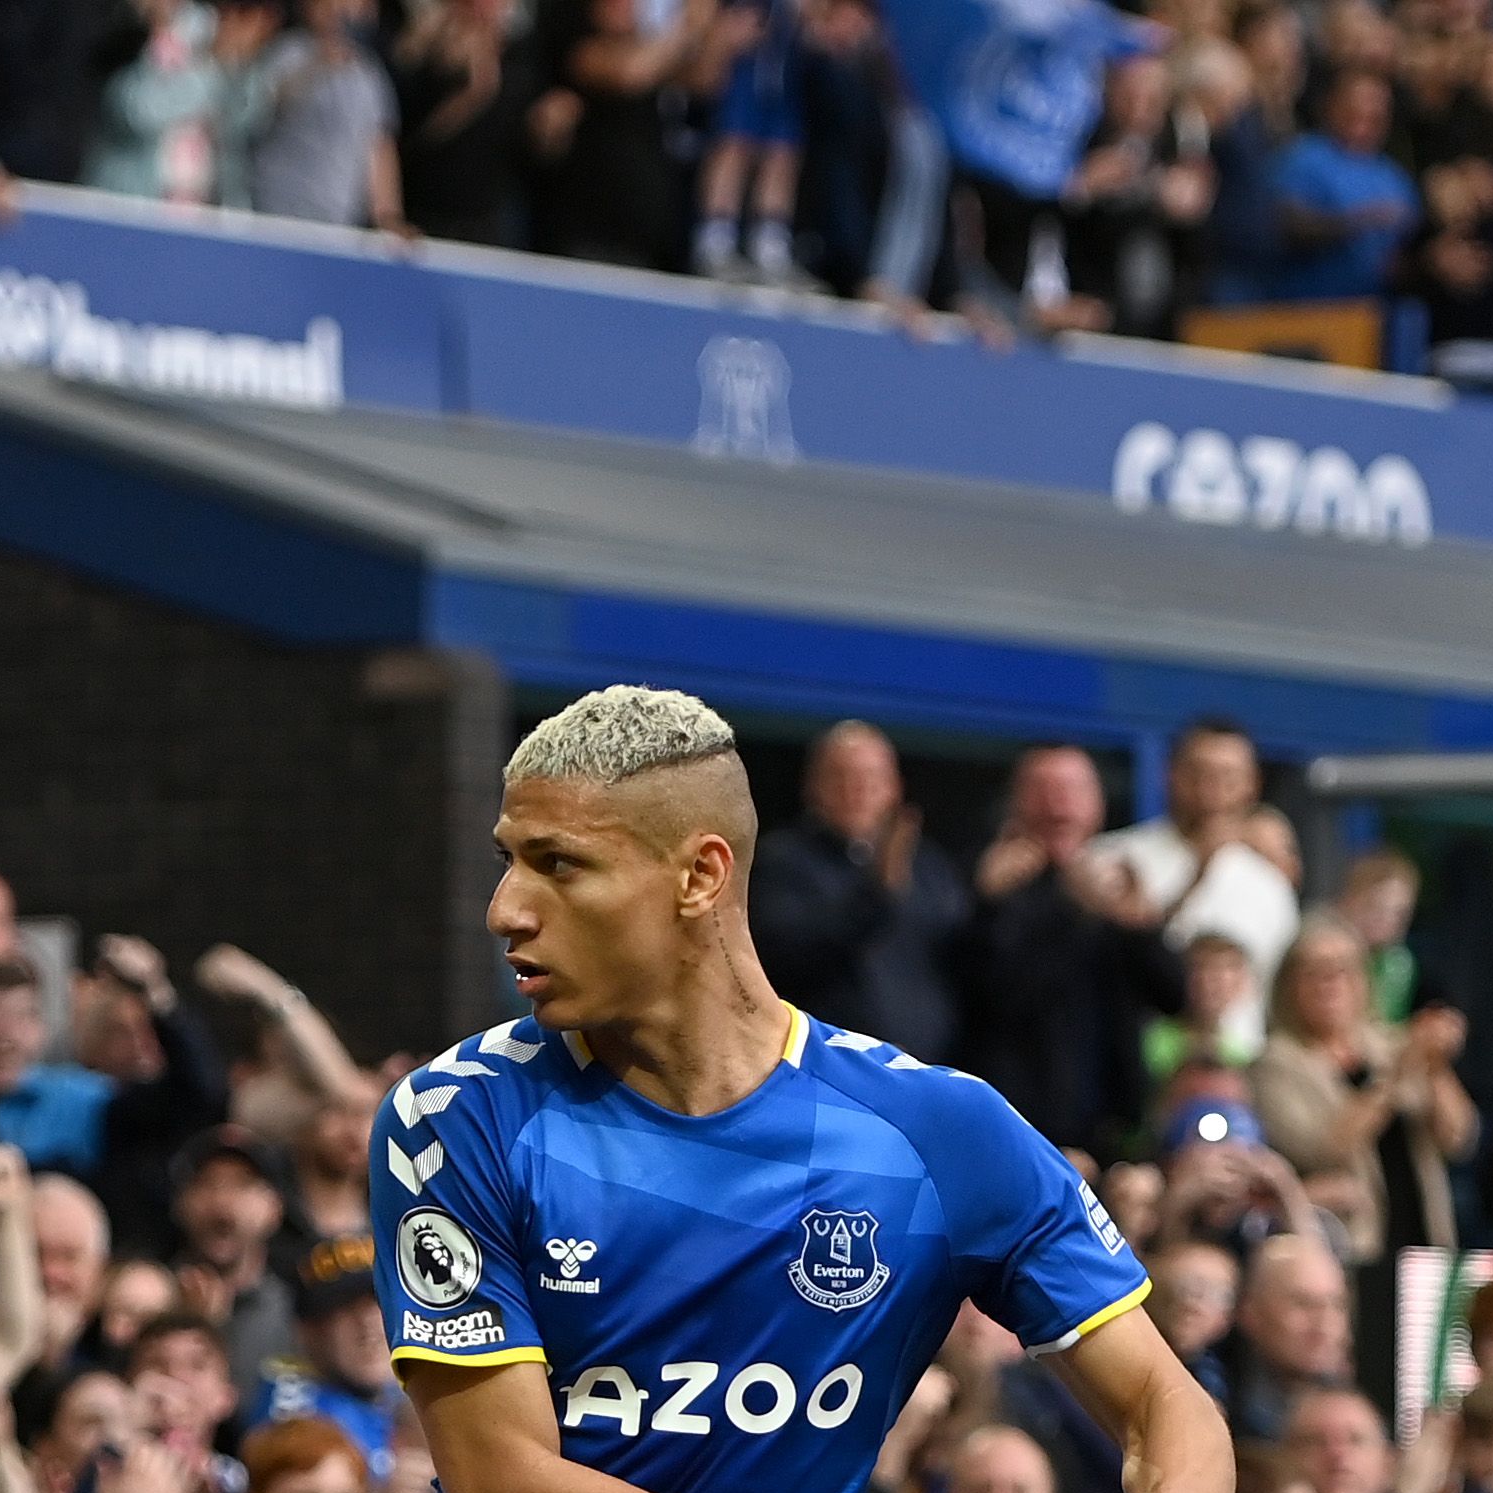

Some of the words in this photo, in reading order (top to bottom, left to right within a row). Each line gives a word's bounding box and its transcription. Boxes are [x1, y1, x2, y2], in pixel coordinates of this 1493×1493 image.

[540, 1273, 600, 1294] hummel
[813, 1264, 864, 1279] Everton
[403, 1310, 434, 1333] No
[436, 1310, 493, 1335] room
[435, 1325, 505, 1349] racism
[547, 1361, 863, 1436] AZOO
